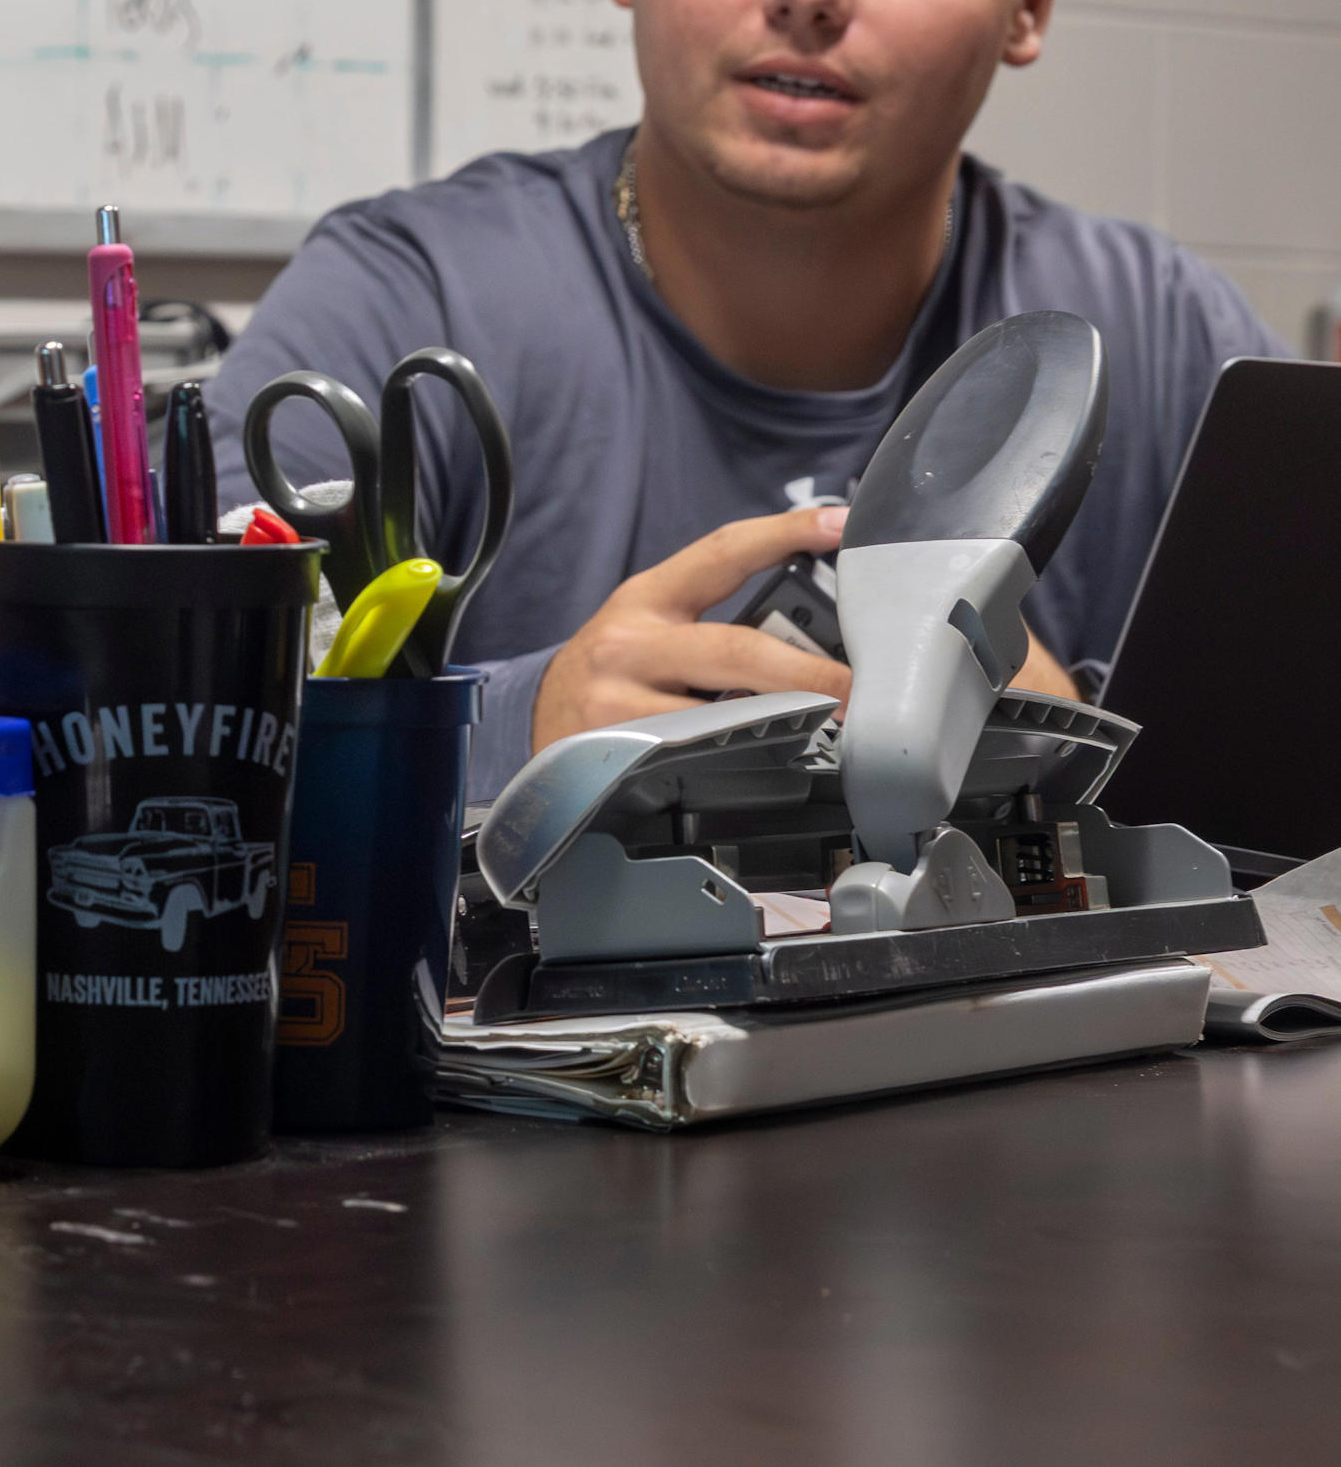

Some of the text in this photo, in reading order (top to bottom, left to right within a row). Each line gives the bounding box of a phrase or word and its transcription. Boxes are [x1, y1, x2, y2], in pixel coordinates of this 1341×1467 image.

[30, 702, 299, 779] HONEYFIRE
[46, 973, 273, 1011] NASHVILLE, TENNESSEE
